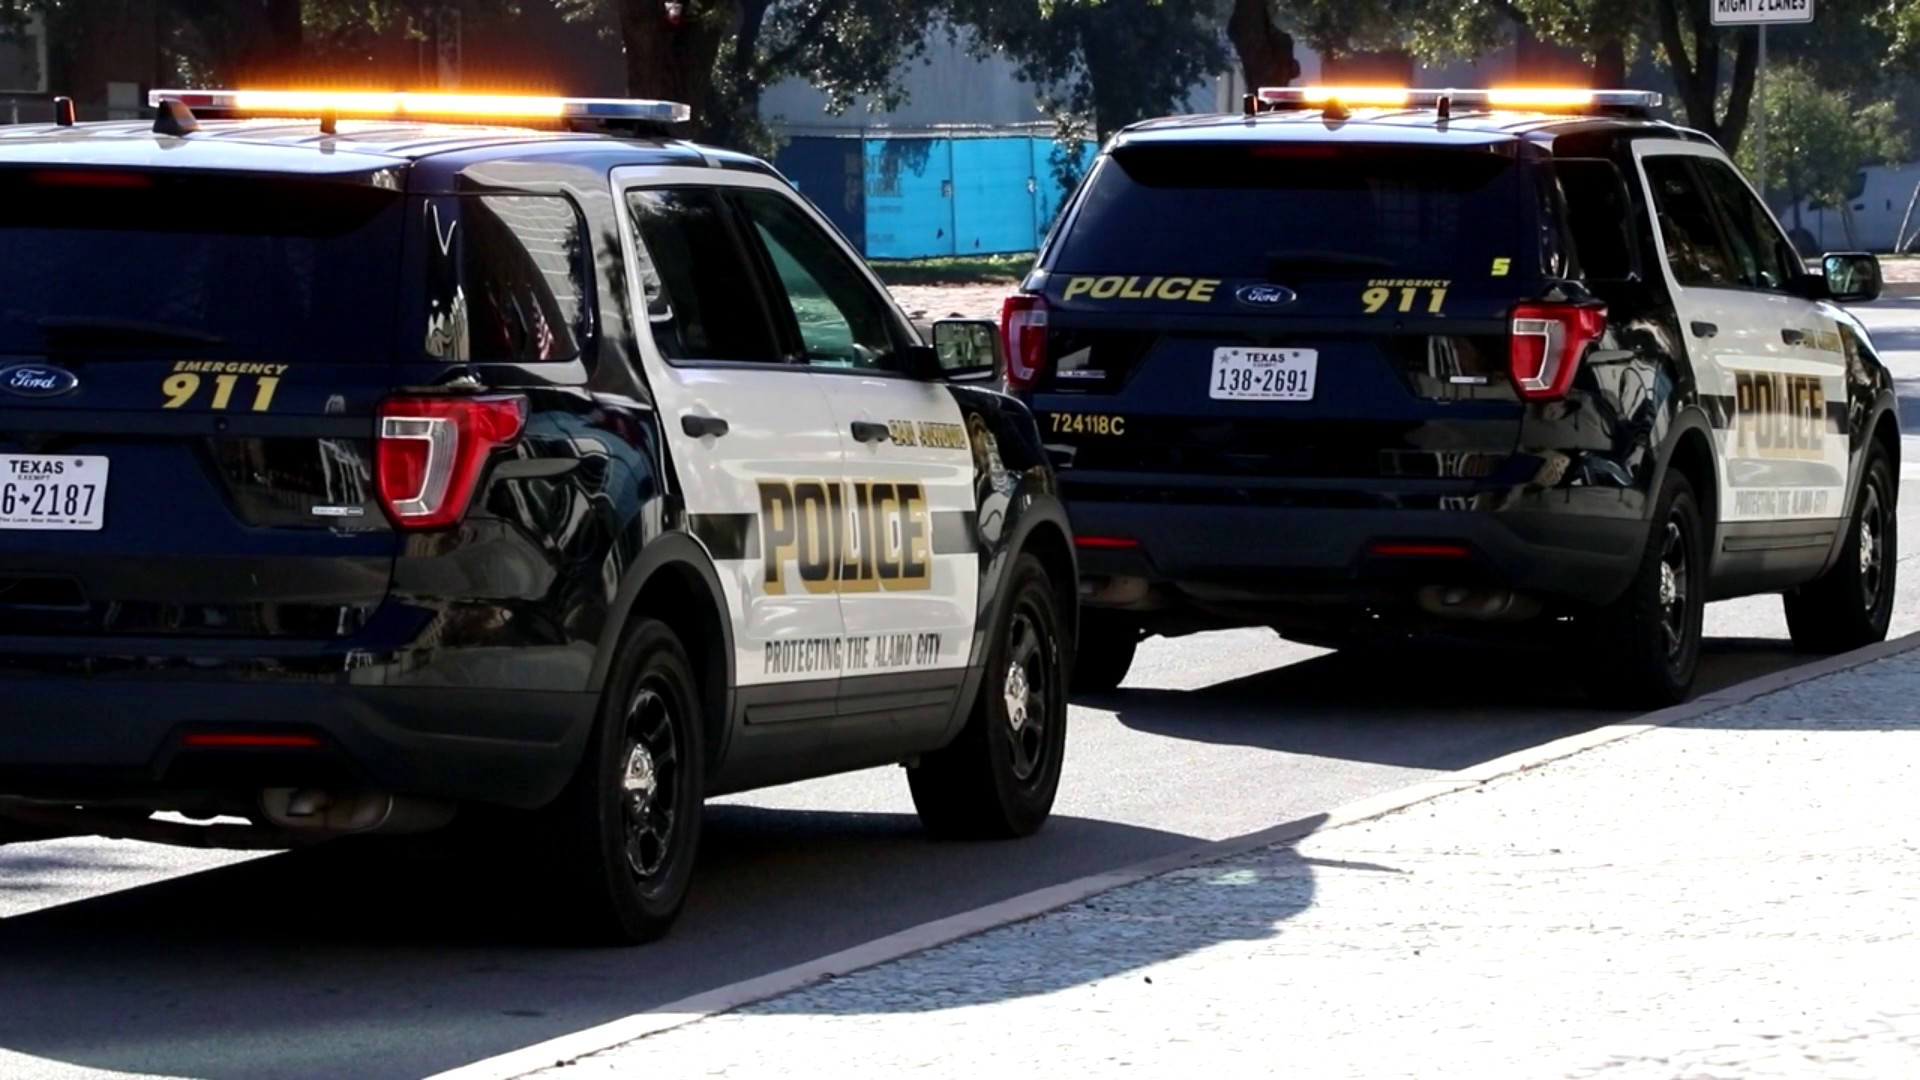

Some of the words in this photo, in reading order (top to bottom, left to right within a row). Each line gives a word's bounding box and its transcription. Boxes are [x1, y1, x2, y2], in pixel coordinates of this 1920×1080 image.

[1718, 0, 1753, 12] RIGHT
[1768, 0, 1806, 11] LANES
[1063, 276, 1221, 302] POLICE
[1367, 279, 1451, 288] EMERGENCY
[1248, 287, 1279, 302] Ford
[1362, 287, 1447, 313] 911
[173, 361, 289, 375] EMERGENCY
[1246, 353, 1285, 363] TEXAS
[10, 369, 57, 389] Ford
[162, 373, 280, 411] 911
[1050, 413, 1125, 435] 724118C
[1734, 370, 1825, 459] POLICE
[9, 460, 64, 474] TEXAS
[755, 477, 932, 595] POLICE
[764, 638, 841, 674] PROTECTING
[846, 637, 870, 669] THE
[873, 633, 913, 667] ALAMO
[915, 633, 942, 665] CITY
